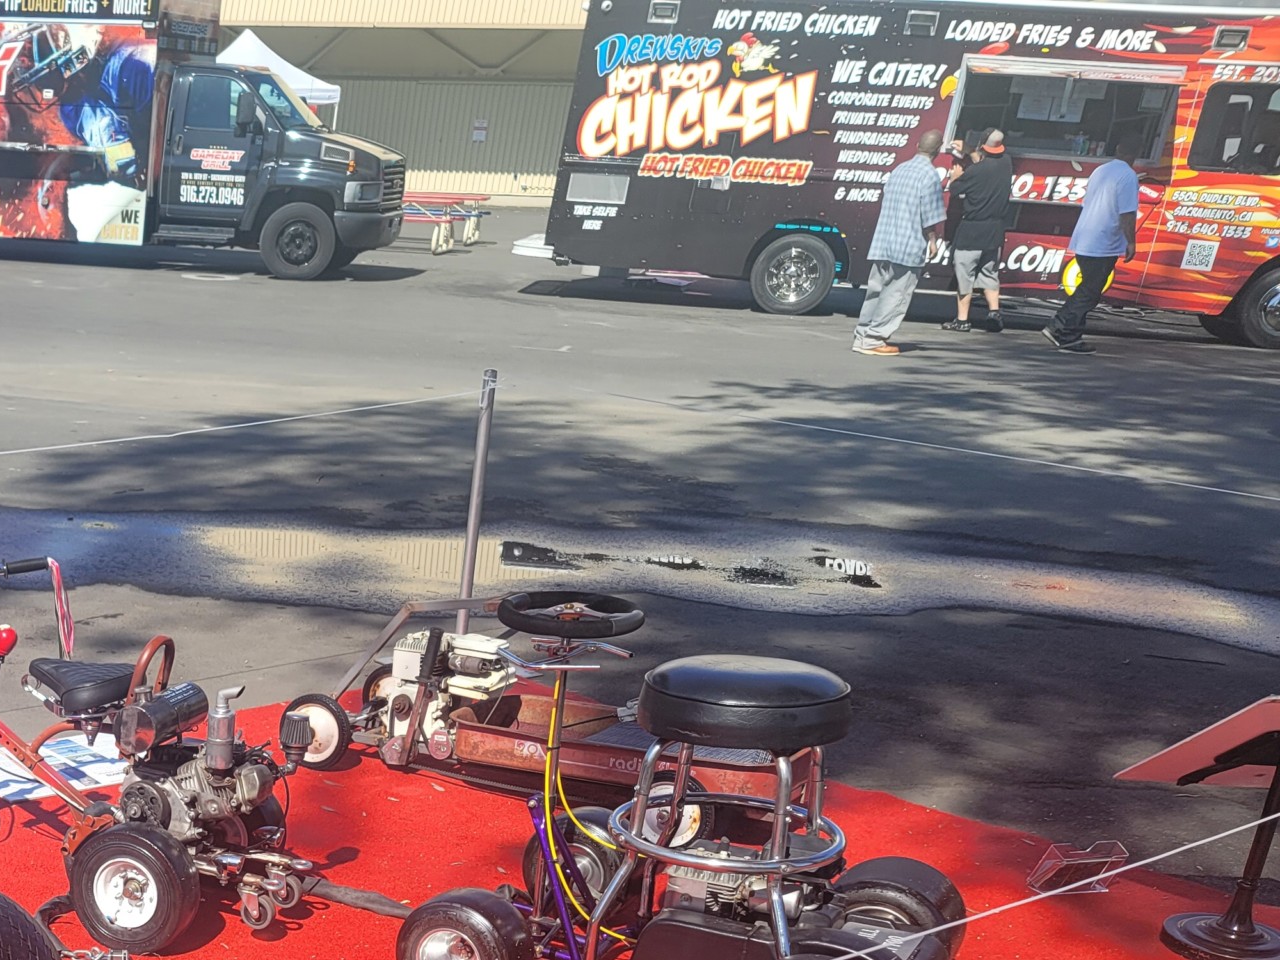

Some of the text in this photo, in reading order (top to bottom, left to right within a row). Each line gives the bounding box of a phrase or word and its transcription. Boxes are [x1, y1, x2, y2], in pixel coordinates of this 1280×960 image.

[713, 9, 881, 37] HOT FRIED CHICKEN
[944, 20, 1158, 52] LOADED FRIES & MORE
[606, 59, 721, 96] HOT ROD
[831, 59, 948, 89] WE CATER!
[1212, 64, 1246, 81] EST.
[827, 90, 935, 110] CORPORATE EVENTS
[577, 70, 818, 160] CHICKEN
[831, 110, 920, 129] PRIVATE EVENTS
[833, 130, 909, 147] FUNDRAISERS
[837, 149, 896, 166] WEDDINGS
[639, 154, 813, 187] HOT FRIED CHICKEN
[833, 169, 892, 184] FESTIVALS
[180, 185, 245, 206] 916.273.0946
[846, 188, 881, 202] MORE
[121, 209, 139, 224] WE
[573, 205, 618, 217] TAKE SELFIE
[1239, 211, 1253, 222] CA
[582, 220, 603, 231] HERE
[1166, 220, 1253, 239] 916.640.1333
[609, 757, 642, 773] radi
